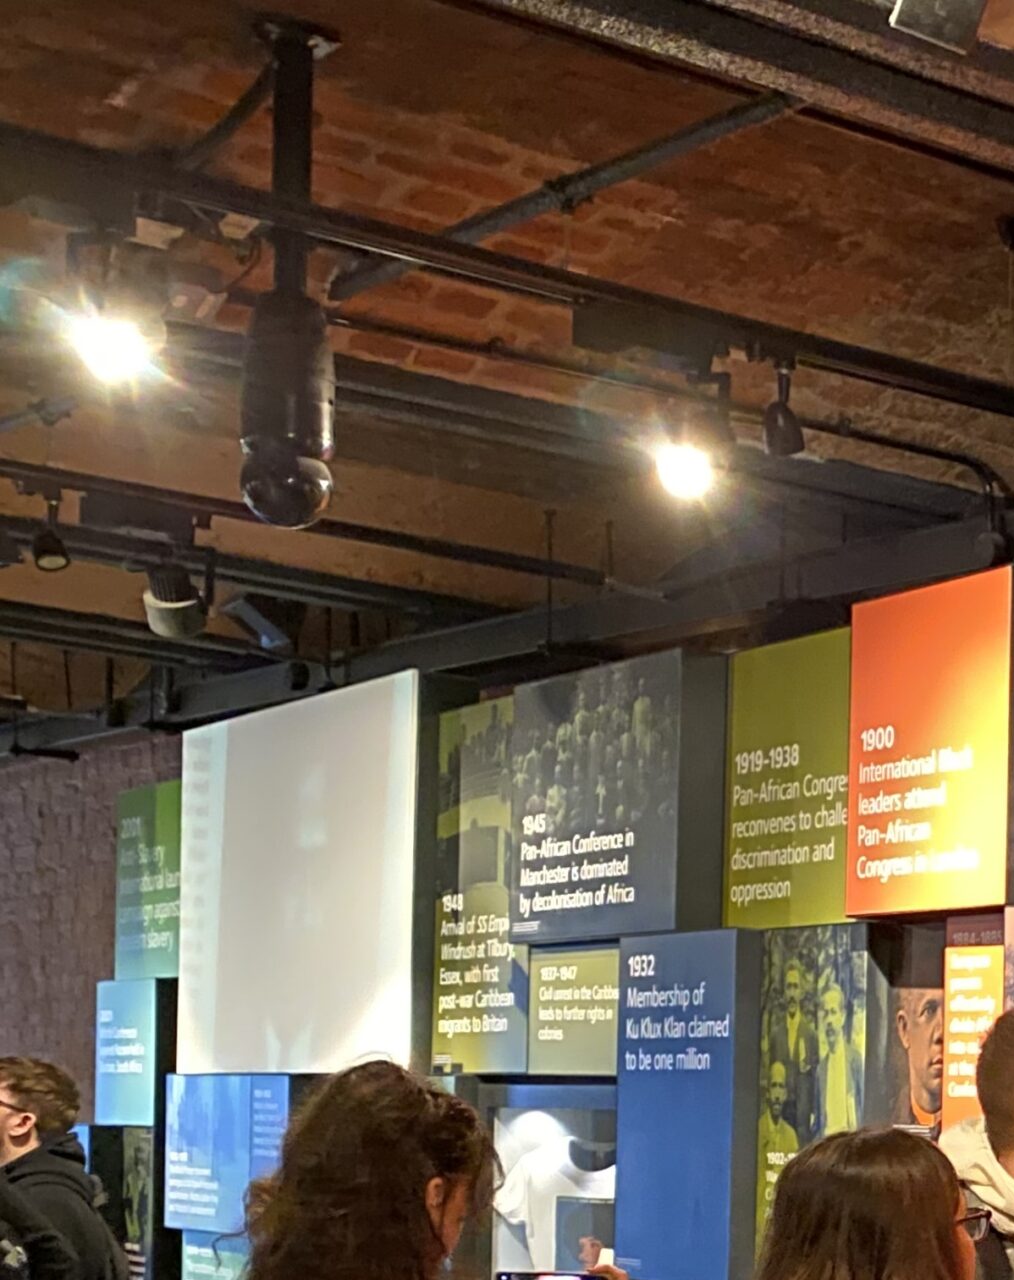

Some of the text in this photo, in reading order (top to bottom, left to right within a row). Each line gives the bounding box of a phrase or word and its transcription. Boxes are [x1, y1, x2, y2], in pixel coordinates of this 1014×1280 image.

[861, 725, 894, 752] 1900
[735, 743, 800, 775] 1919-1938
[859, 748, 937, 784] International
[733, 778, 800, 807] Pan-African
[858, 789, 902, 816] leaders
[732, 813, 796, 838] reconvenes
[799, 810, 812, 830] to
[857, 818, 931, 847] Pan-African
[520, 827, 634, 861] Pan-African Conference in
[731, 836, 835, 871] discrimination and
[520, 854, 629, 887] Manchester is dominated
[519, 892, 531, 918] by
[594, 883, 606, 905] of
[606, 882, 635, 904] Africa
[730, 876, 791, 907] oppression
[466, 915, 476, 935] of
[476, 915, 488, 935] SS
[483, 963, 500, 983] first
[628, 953, 656, 978] 1932
[626, 983, 691, 1013] Membership
[692, 981, 707, 1007] of
[625, 1013, 730, 1040] Ku Klux Klan claimed
[624, 1046, 711, 1071] to be one million
